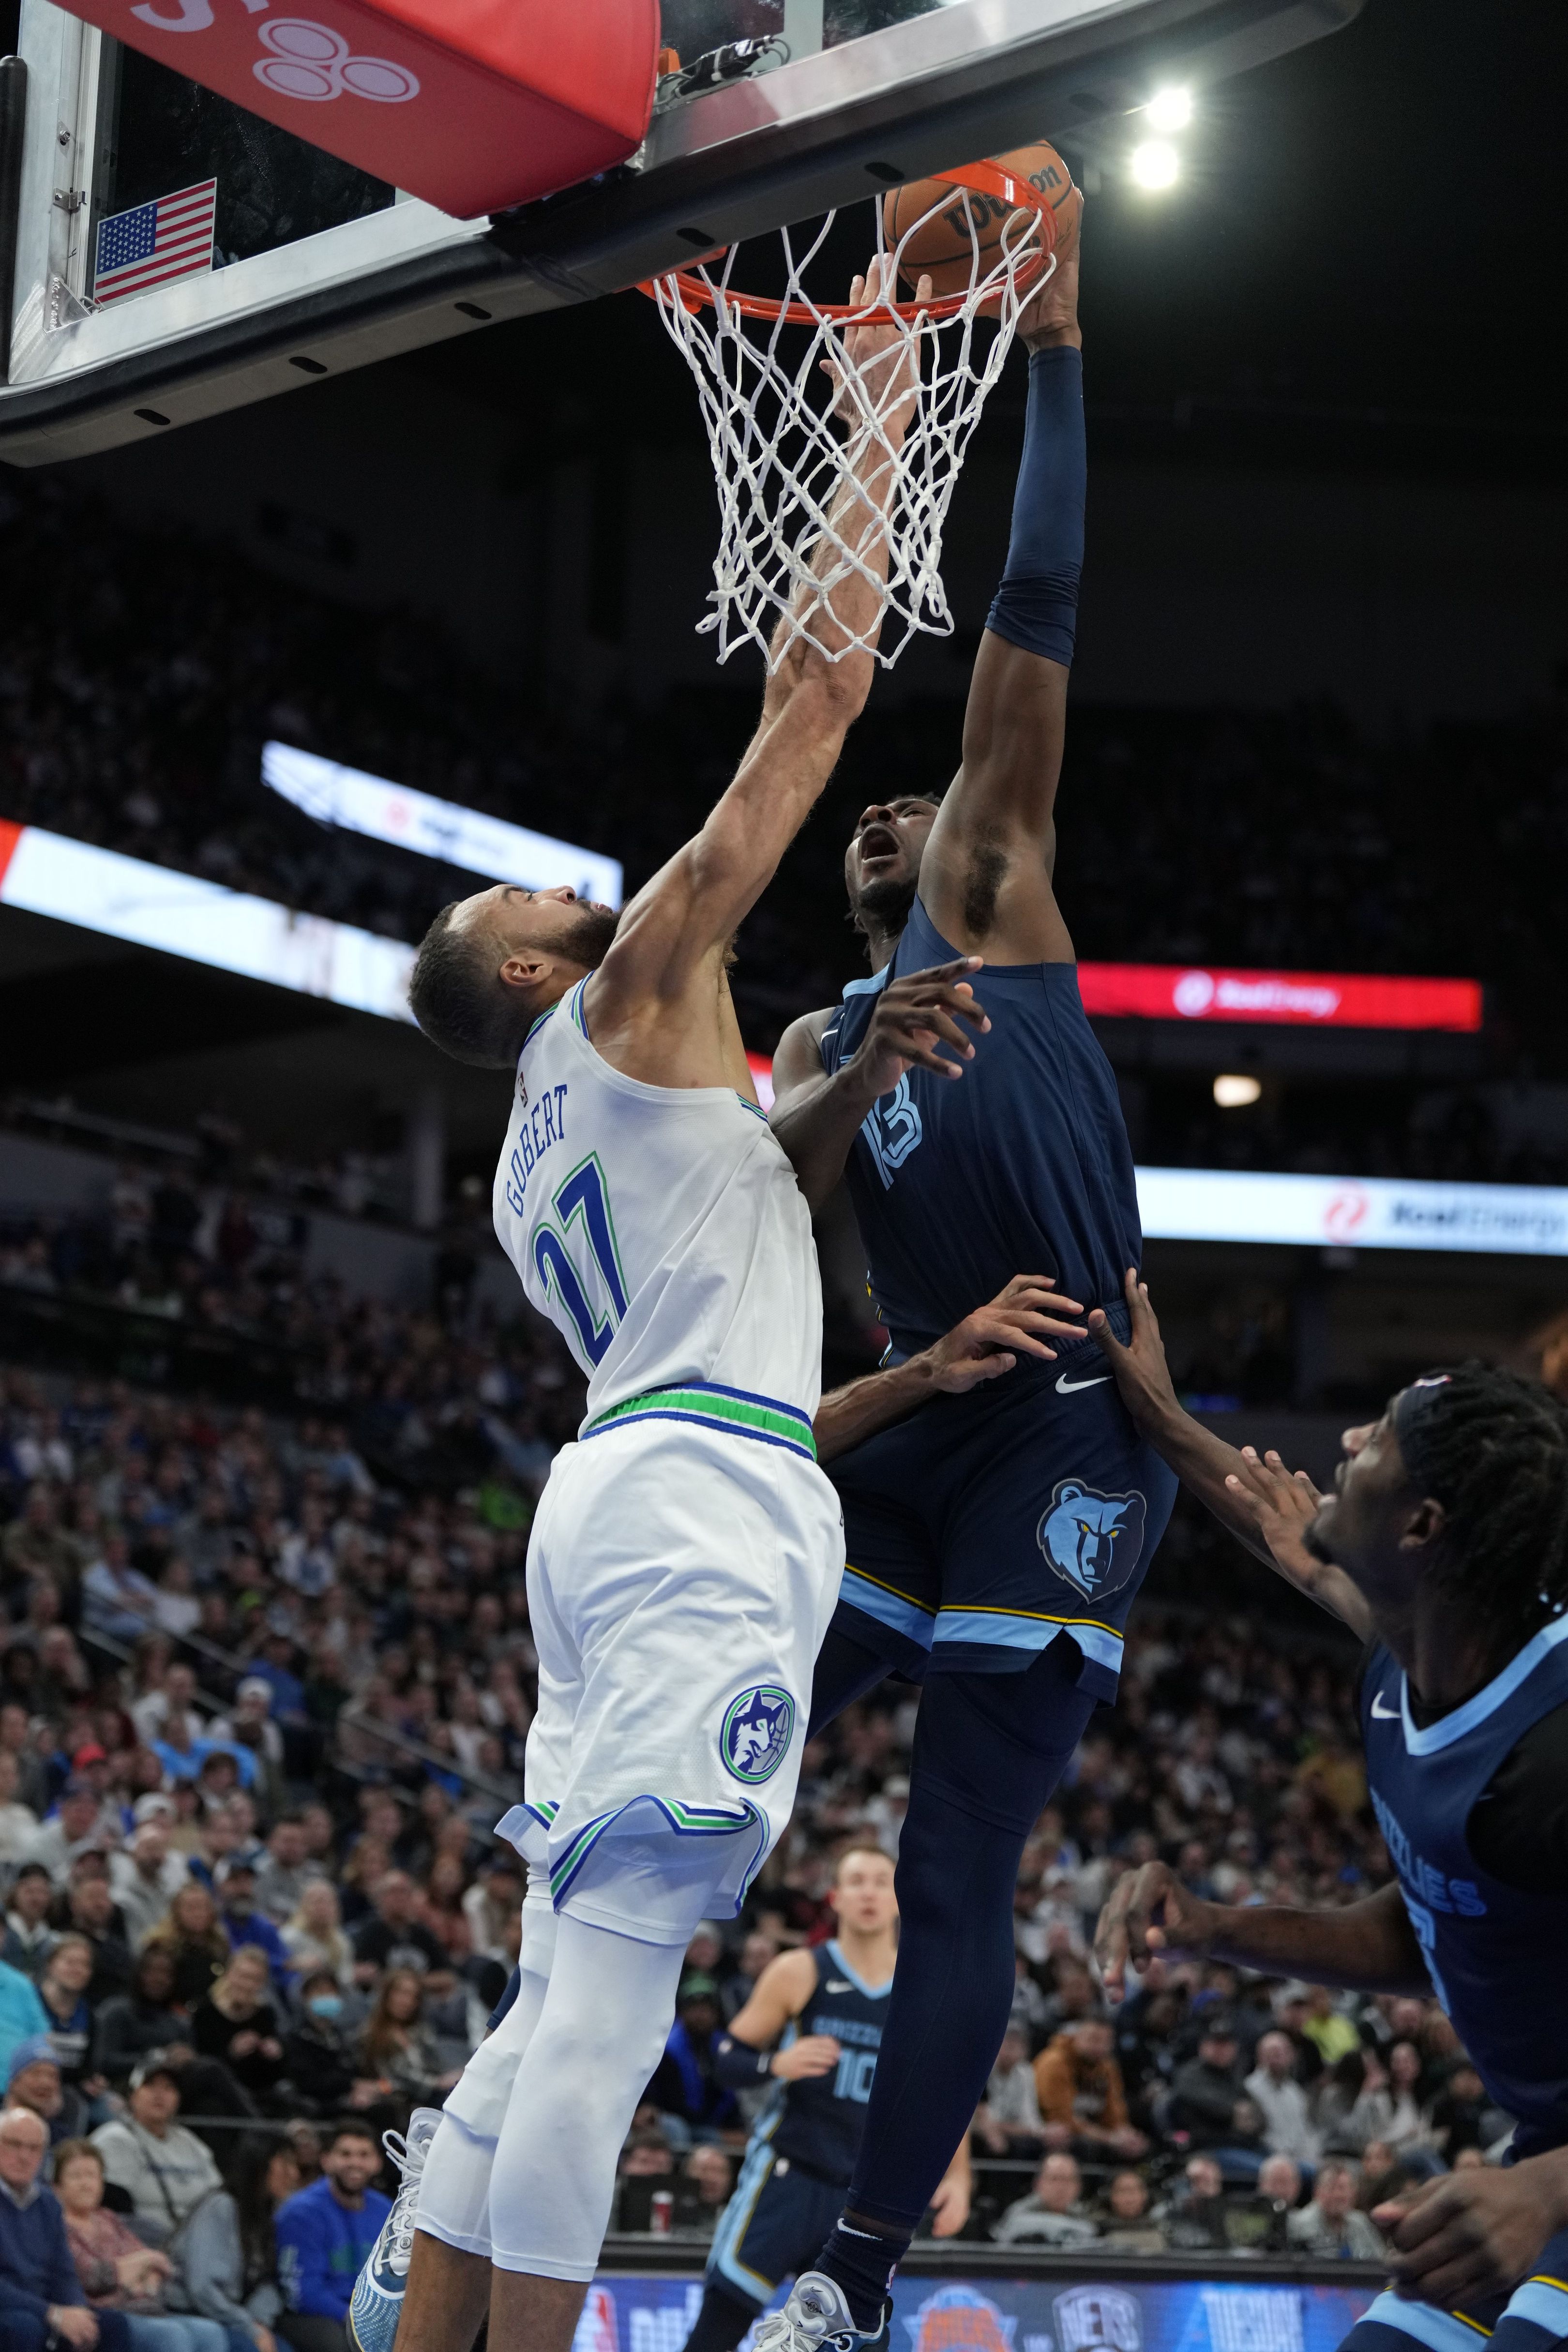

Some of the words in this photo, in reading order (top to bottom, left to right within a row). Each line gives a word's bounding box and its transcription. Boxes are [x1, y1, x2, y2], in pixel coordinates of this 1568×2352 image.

[943, 165, 1062, 238] Wion
[507, 1084, 568, 1218] GOBERT
[859, 1071, 922, 1191] 13
[533, 1150, 631, 1371] 27
[833, 2047, 878, 2104] 10
